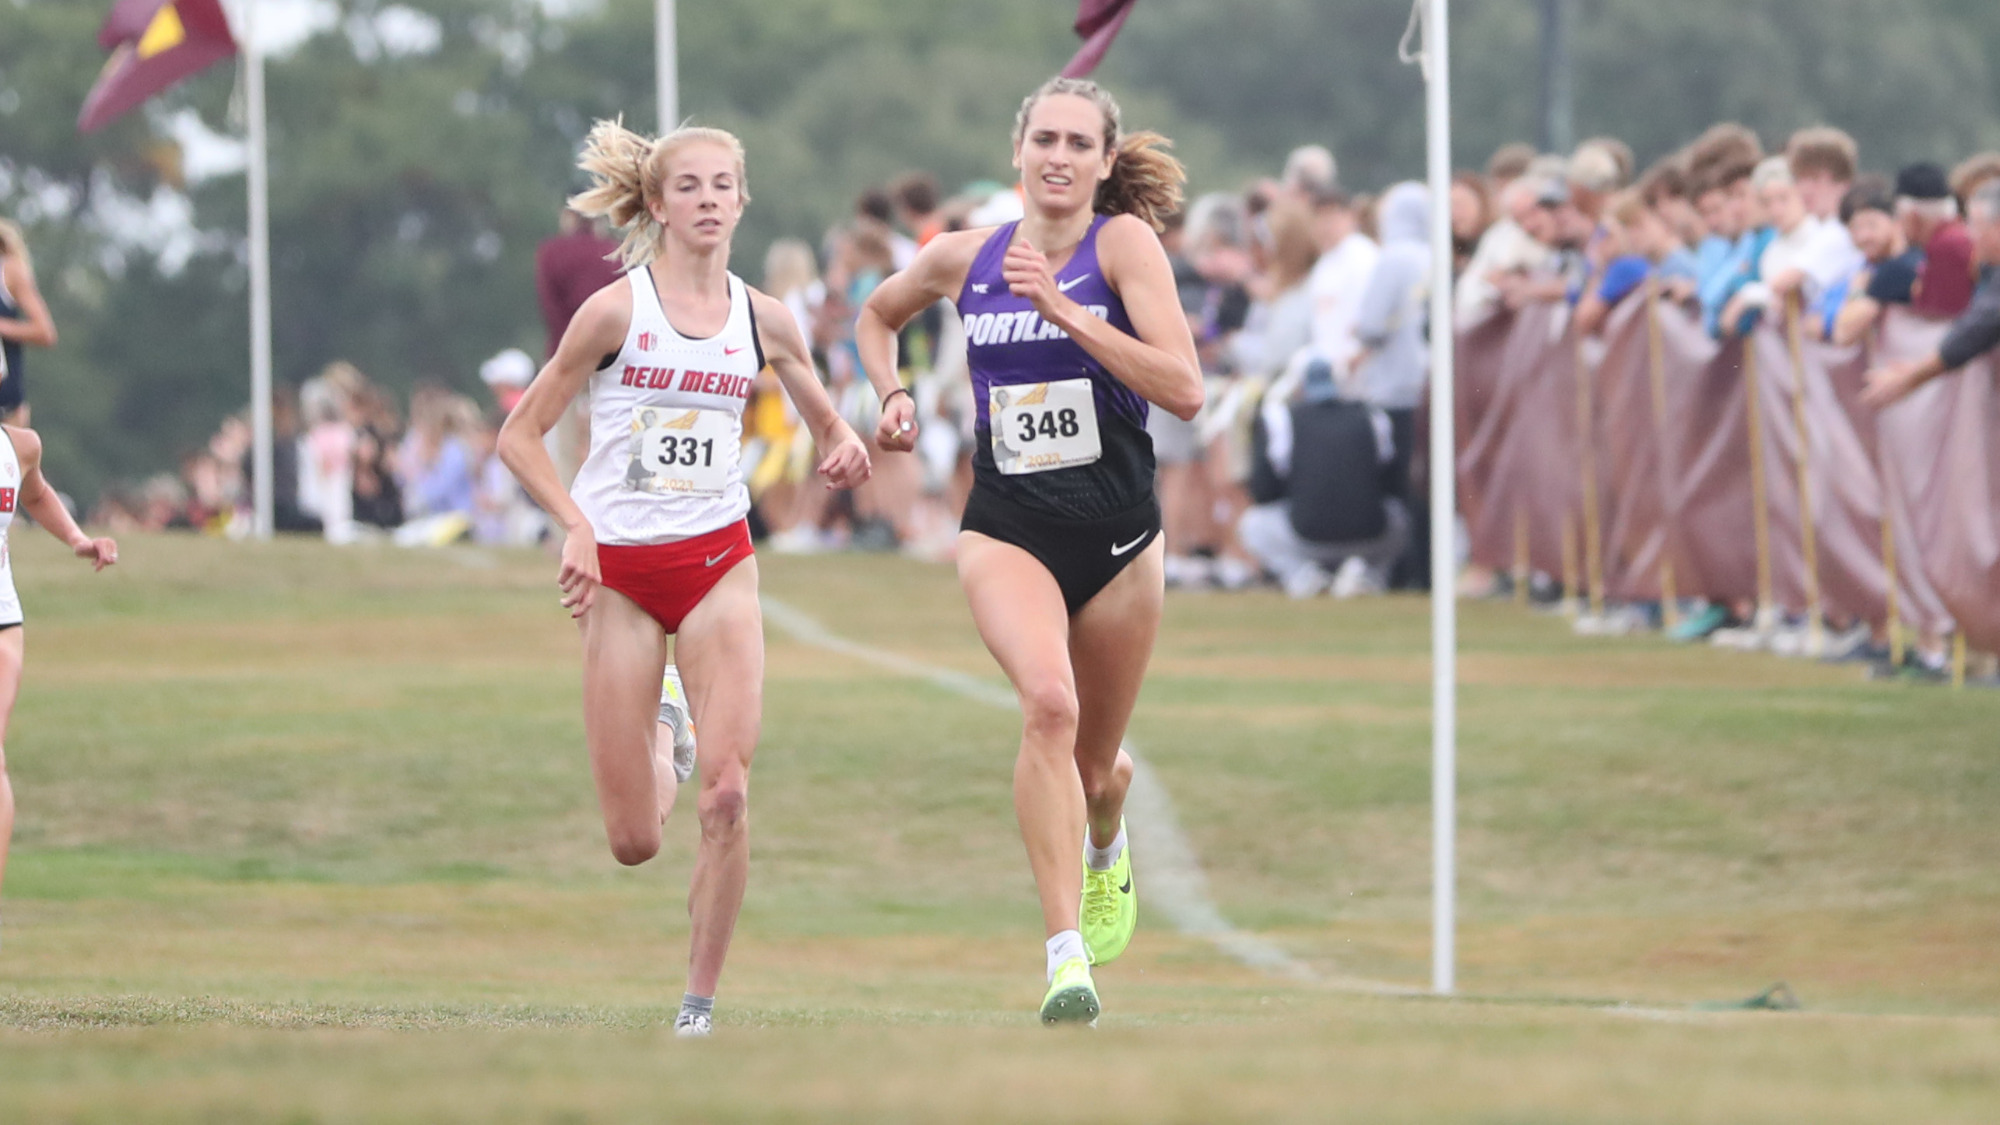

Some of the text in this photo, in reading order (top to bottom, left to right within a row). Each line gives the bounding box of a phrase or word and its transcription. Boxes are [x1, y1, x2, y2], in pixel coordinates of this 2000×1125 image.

[964, 305, 1108, 346] PORTLA
[621, 365, 675, 390] NEW
[1017, 408, 1079, 442] 348
[658, 436, 713, 467] 331
